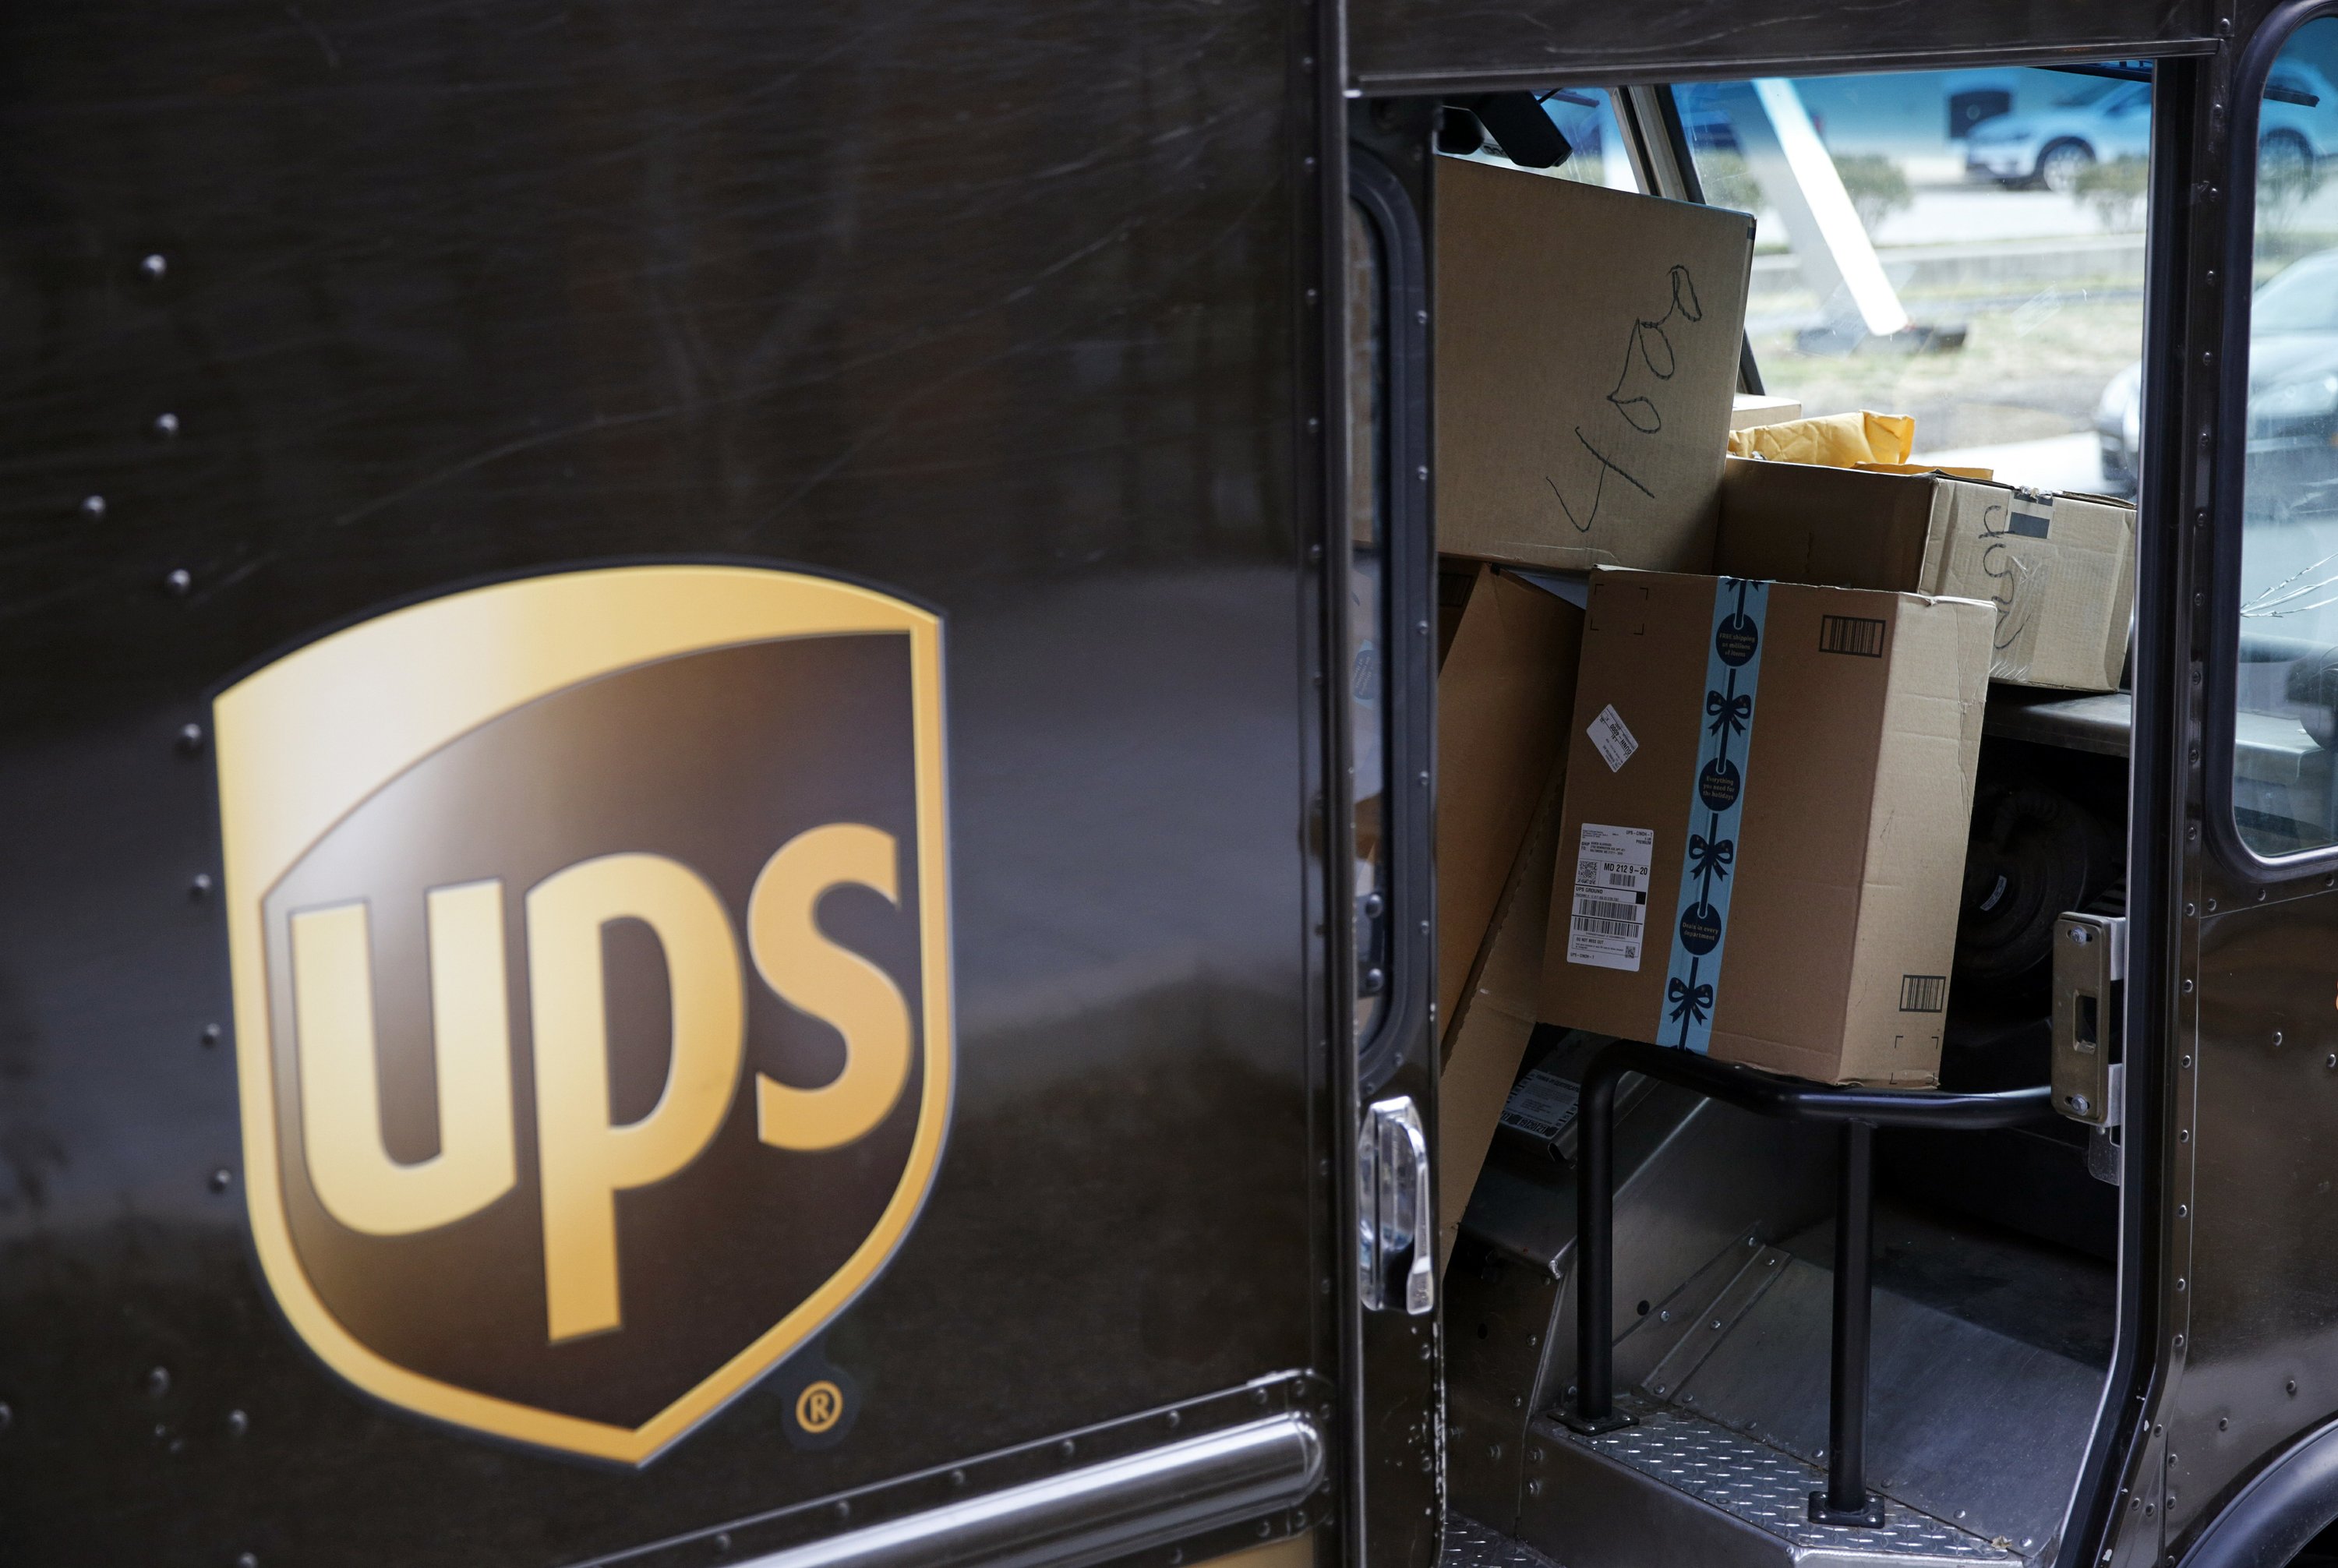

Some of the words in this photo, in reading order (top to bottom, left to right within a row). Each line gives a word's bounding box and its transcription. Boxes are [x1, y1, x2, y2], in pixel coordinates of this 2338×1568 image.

[1733, 634, 1755, 643] shipping
[1620, 740, 1632, 755] GUNN
[1707, 775, 1733, 786] Everything
[1712, 791, 1733, 800] holidays
[1616, 864, 1627, 873] 212
[1684, 931, 1715, 941] department
[288, 821, 914, 1345] ups
